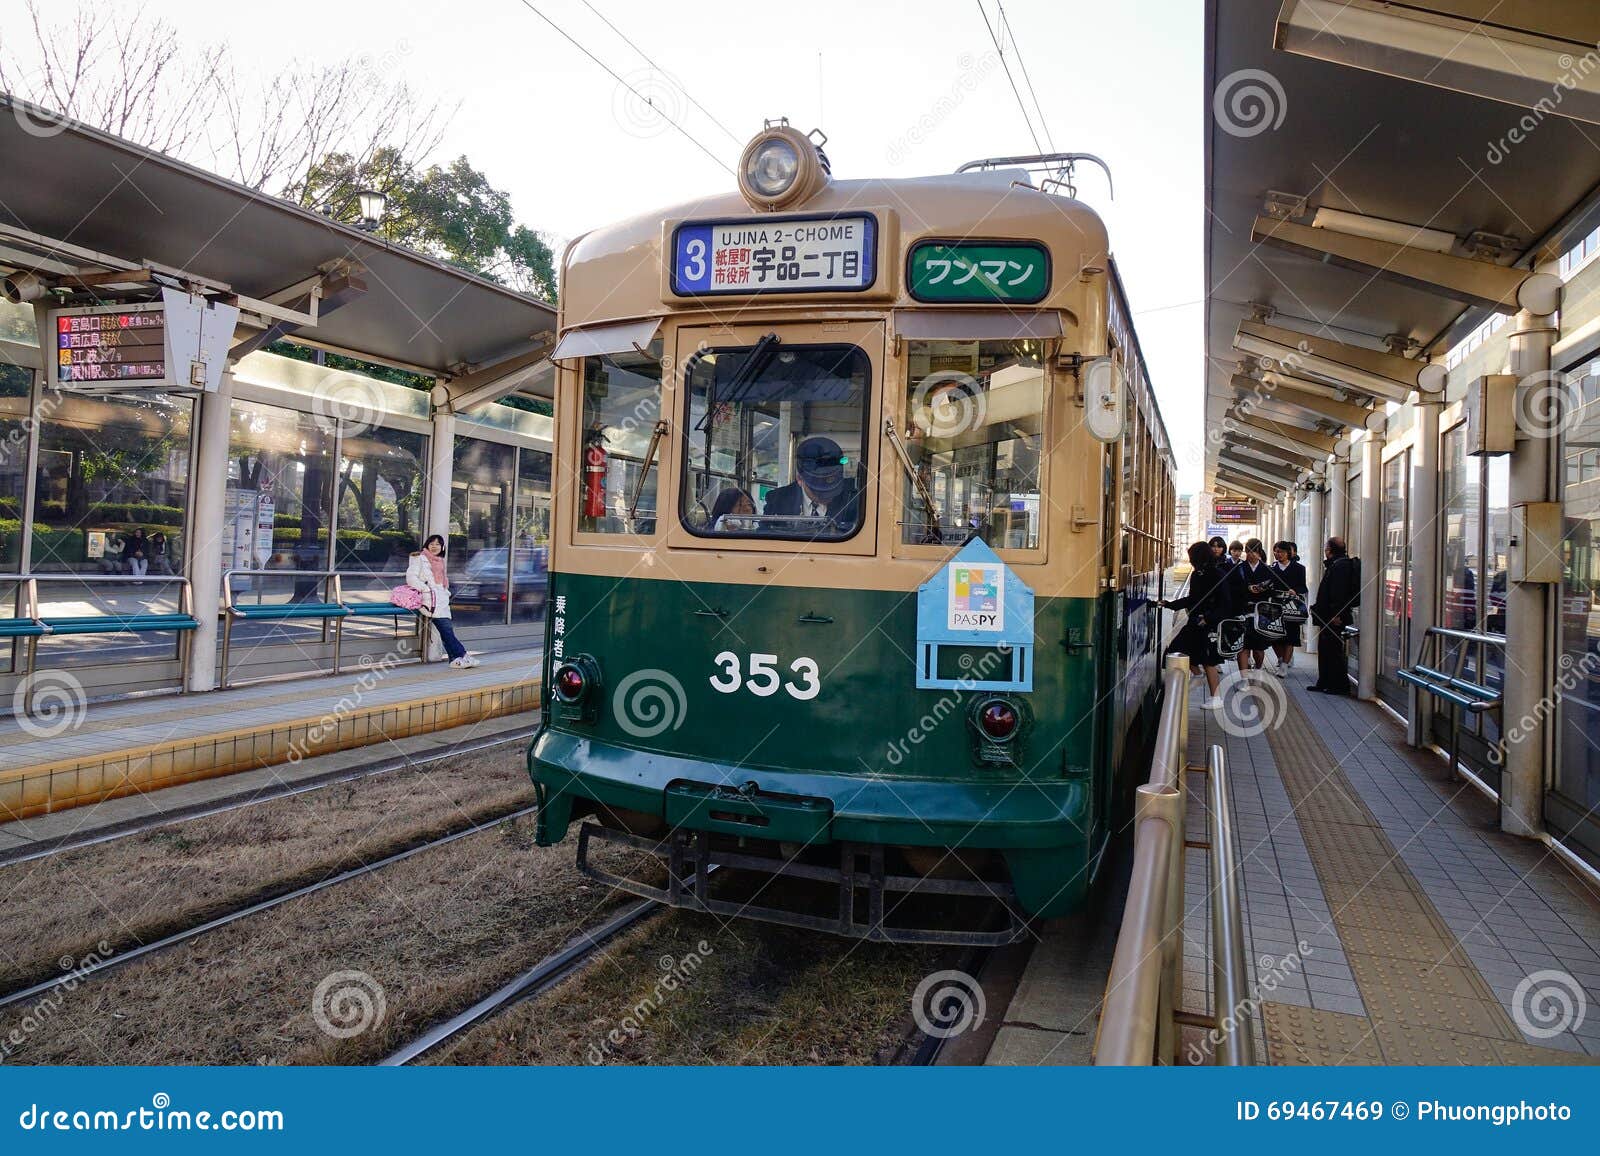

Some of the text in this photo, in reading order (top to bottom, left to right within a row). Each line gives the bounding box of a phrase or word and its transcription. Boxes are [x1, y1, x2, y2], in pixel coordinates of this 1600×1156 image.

[722, 225, 854, 246] UJINA 2-CHOME
[685, 239, 706, 281] 3
[715, 248, 751, 266] 紙屋町
[752, 246, 859, 283] 宇品二丁目
[715, 266, 750, 284] 市役所
[926, 259, 1034, 286] ワンマン
[953, 613, 997, 626] PASPY
[709, 651, 821, 700] 353
